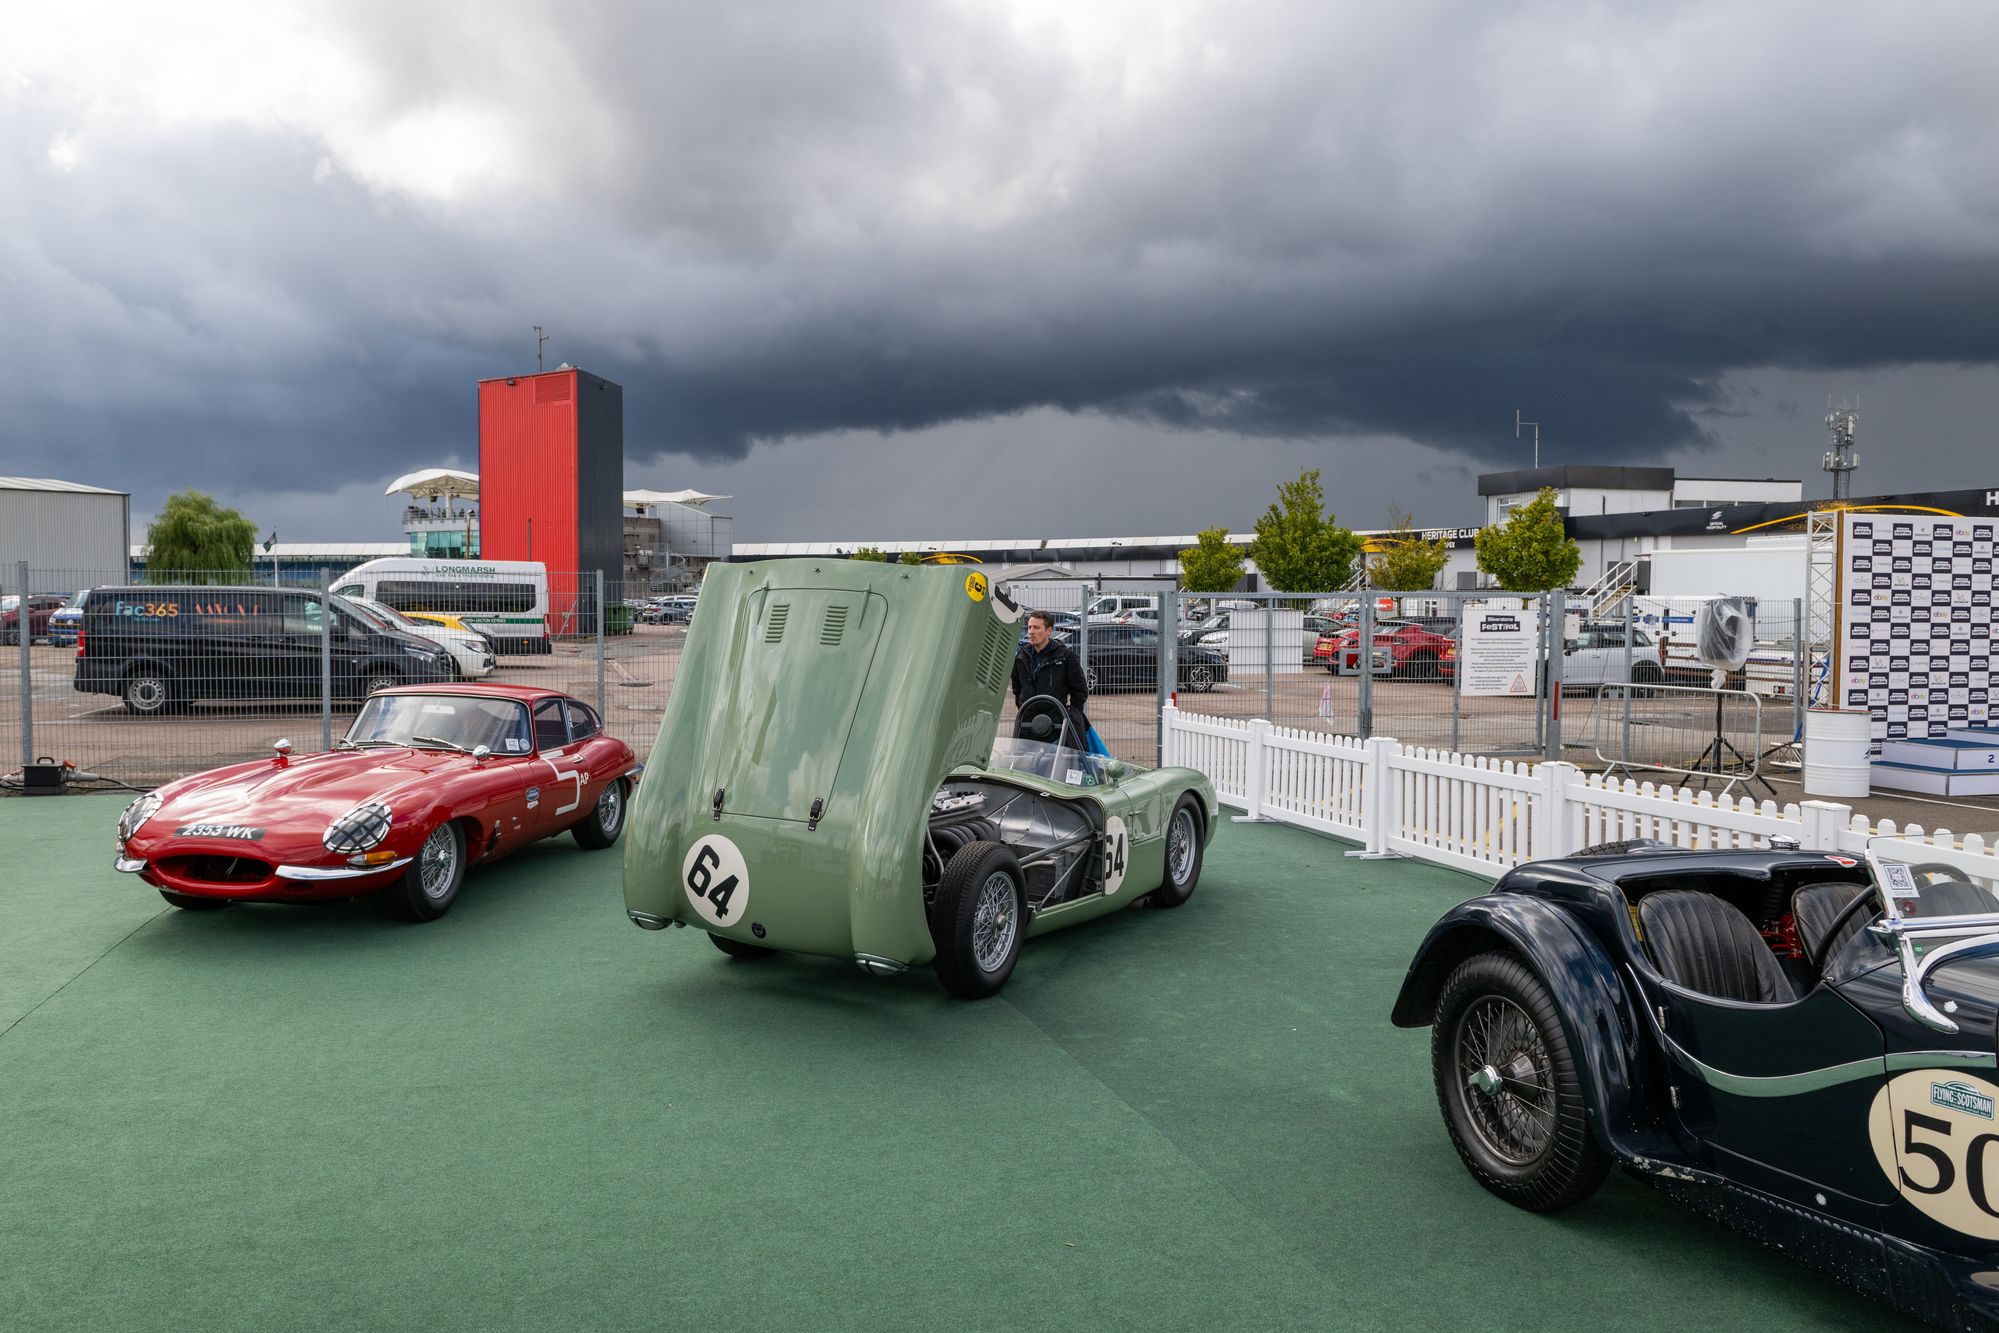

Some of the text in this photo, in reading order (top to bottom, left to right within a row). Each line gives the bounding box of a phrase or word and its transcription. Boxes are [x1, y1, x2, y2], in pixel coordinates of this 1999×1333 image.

[1986, 491, 1999, 506] H
[1421, 528, 1480, 541] HERITAGE CLUB
[435, 565, 496, 574] LONGMARSH
[115, 601, 179, 617] fac365
[1988, 754, 1995, 763] 2
[580, 772, 590, 786] AP
[182, 824, 258, 839] 2353 WK
[687, 844, 740, 920] 64
[1933, 1086, 1992, 1113] FLYING SCOTSMAN
